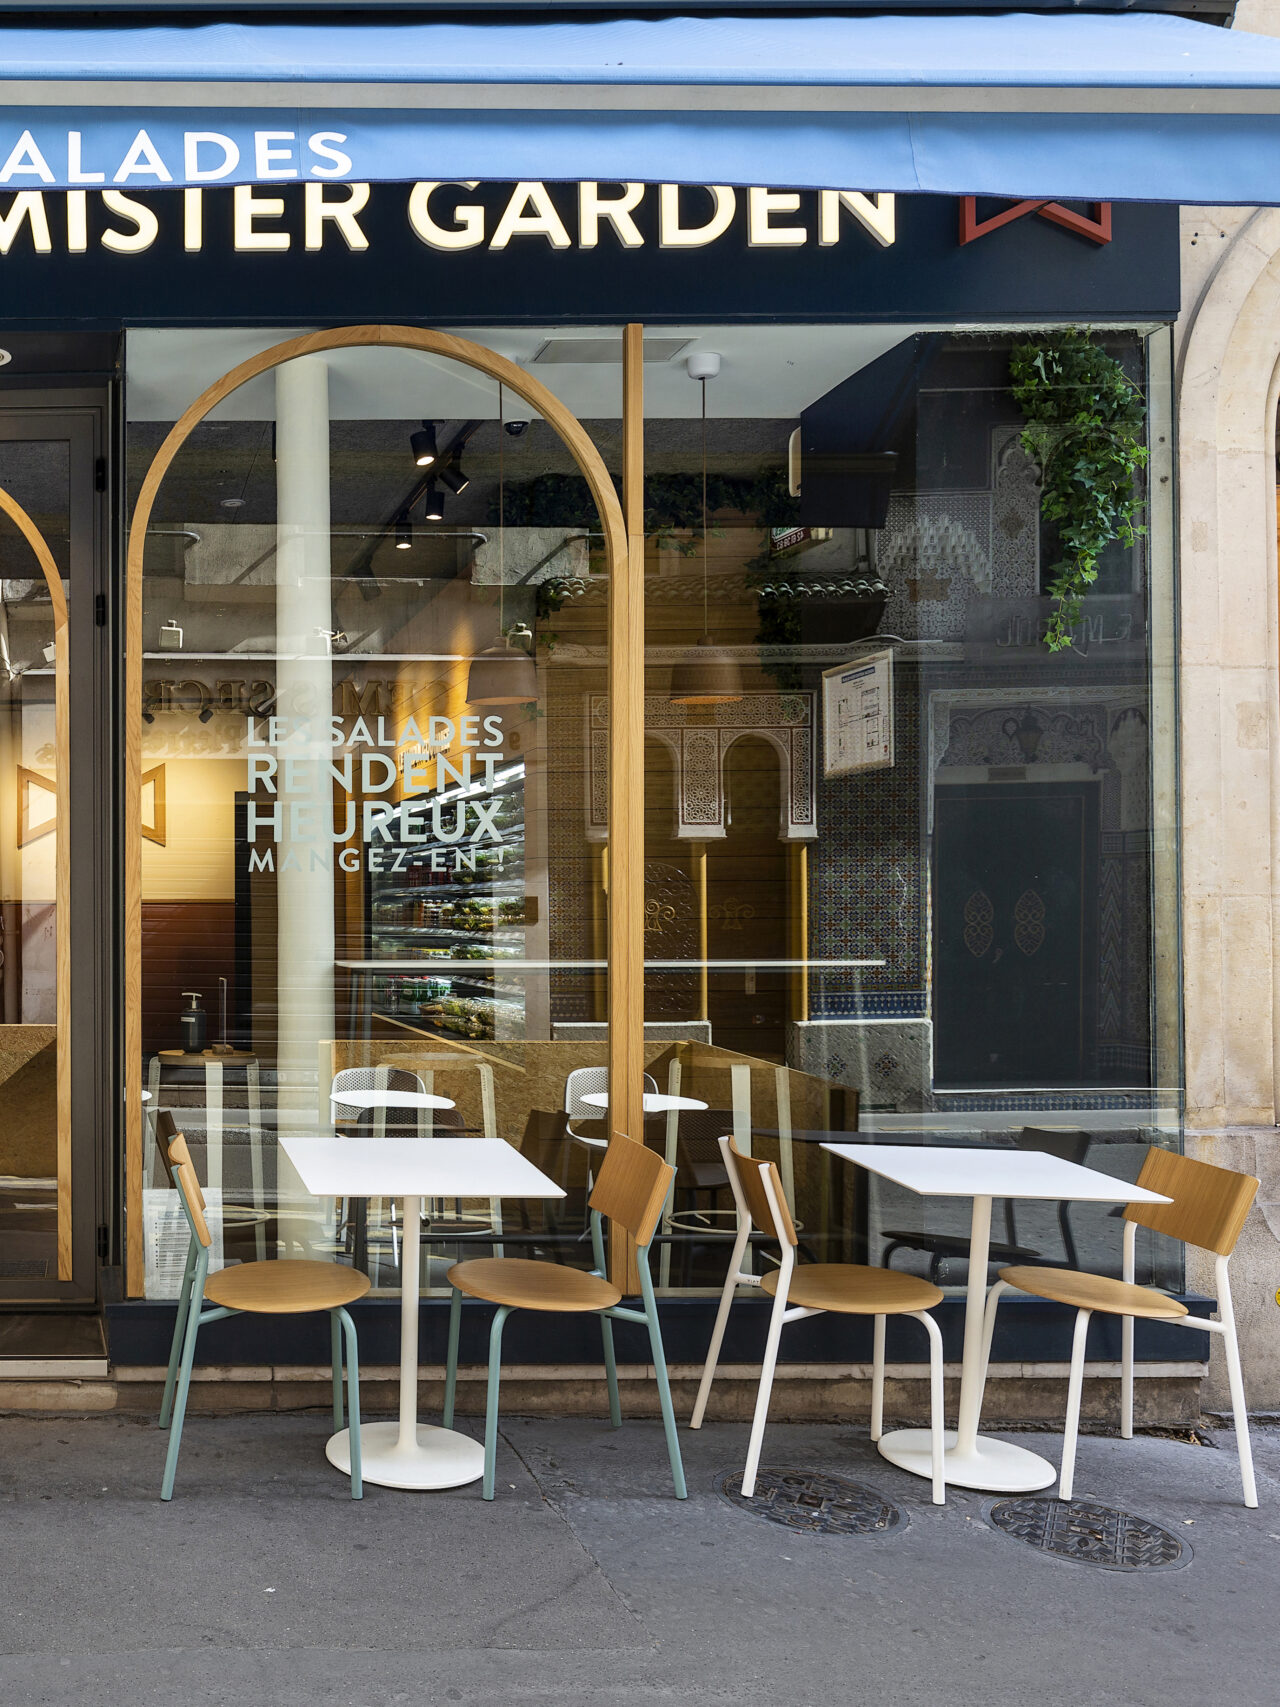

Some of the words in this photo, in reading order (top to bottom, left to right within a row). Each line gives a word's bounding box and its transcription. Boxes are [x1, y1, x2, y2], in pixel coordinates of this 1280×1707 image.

[407, 180, 898, 251] GARDEN
[247, 715, 313, 748] LES
[326, 714, 505, 748] SALADES
[247, 752, 505, 794] RENDENT
[247, 799, 505, 843] HEUREUX
[248, 847, 477, 873] MANGEZ-EN
